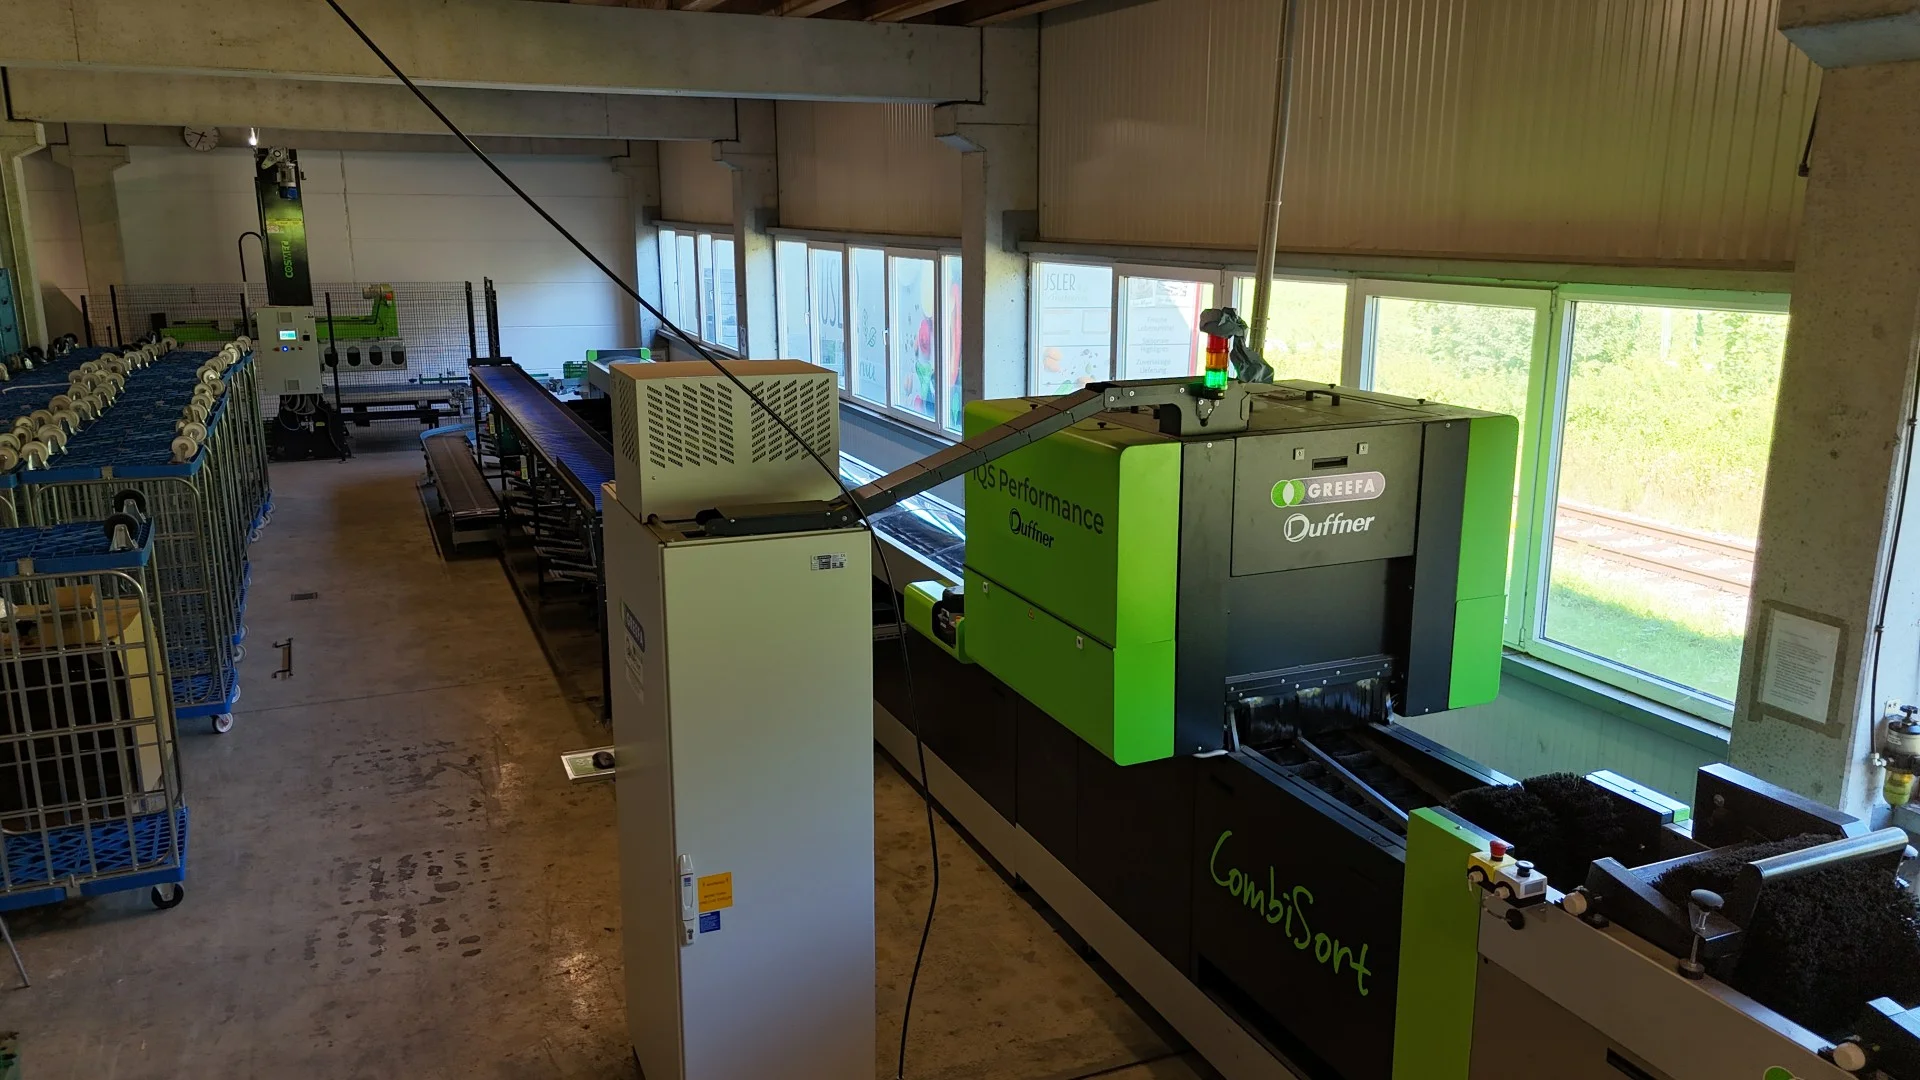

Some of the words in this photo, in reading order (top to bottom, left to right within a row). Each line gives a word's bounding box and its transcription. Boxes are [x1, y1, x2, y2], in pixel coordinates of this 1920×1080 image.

[1000, 468, 1104, 534] Performance
[1308, 479, 1375, 498] GREEFA
[1009, 508, 1054, 548] Duffner
[1284, 512, 1375, 543] Duffner
[1210, 830, 1371, 996] CombiSort
